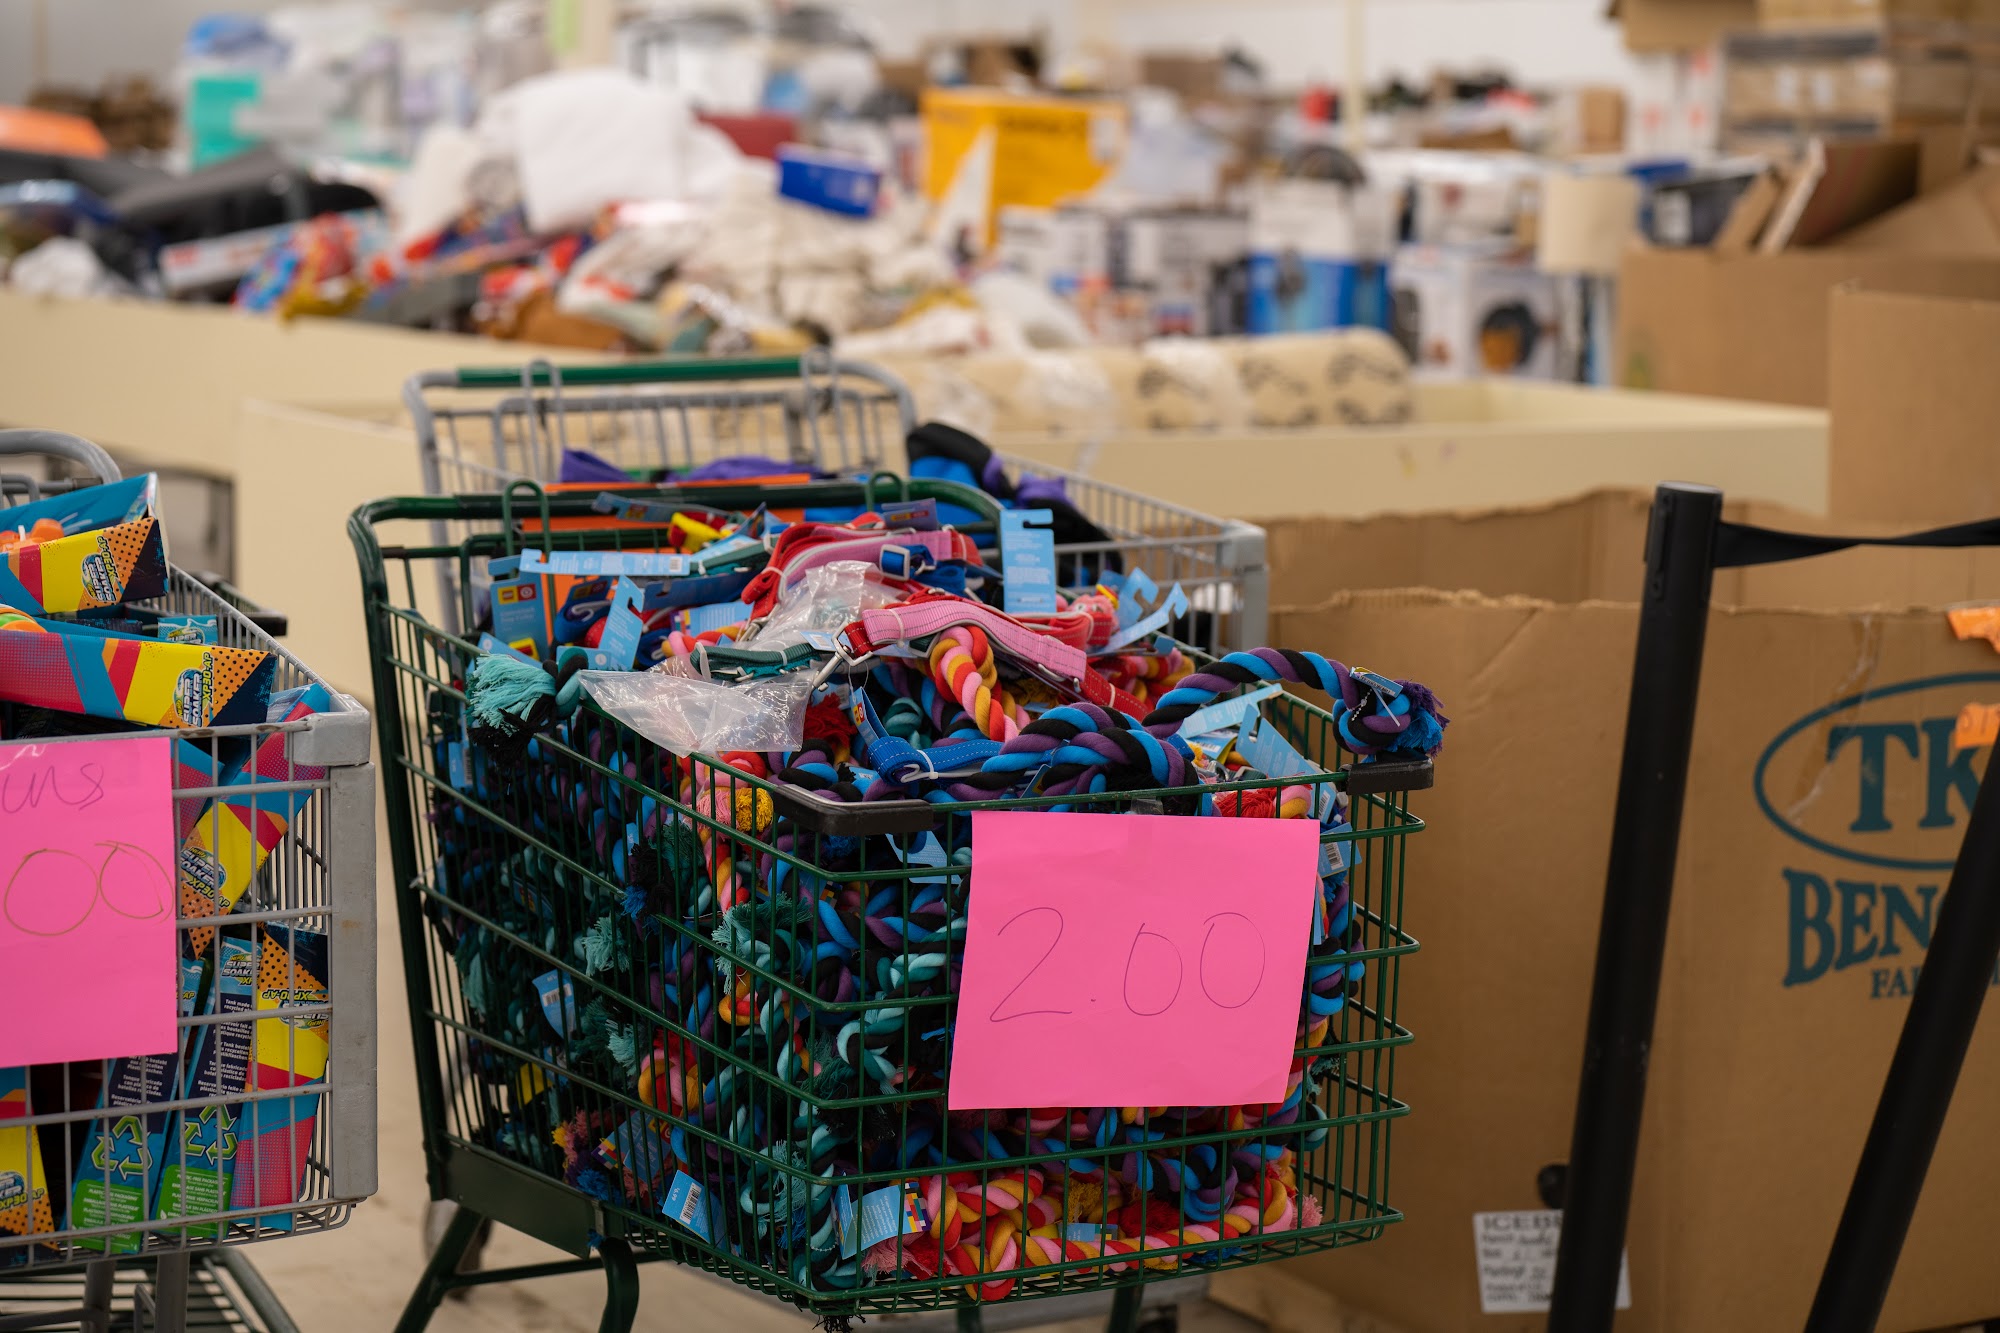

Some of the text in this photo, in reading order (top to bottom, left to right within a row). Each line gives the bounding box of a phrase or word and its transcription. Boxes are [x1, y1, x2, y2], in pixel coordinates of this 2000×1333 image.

[183, 678, 193, 724] SUPER
[192, 673, 203, 727] SOAKER
[1782, 867, 1947, 988] BEN
[990, 907, 1266, 1022] 2.00
[261, 989, 310, 1001] XP0-AP
